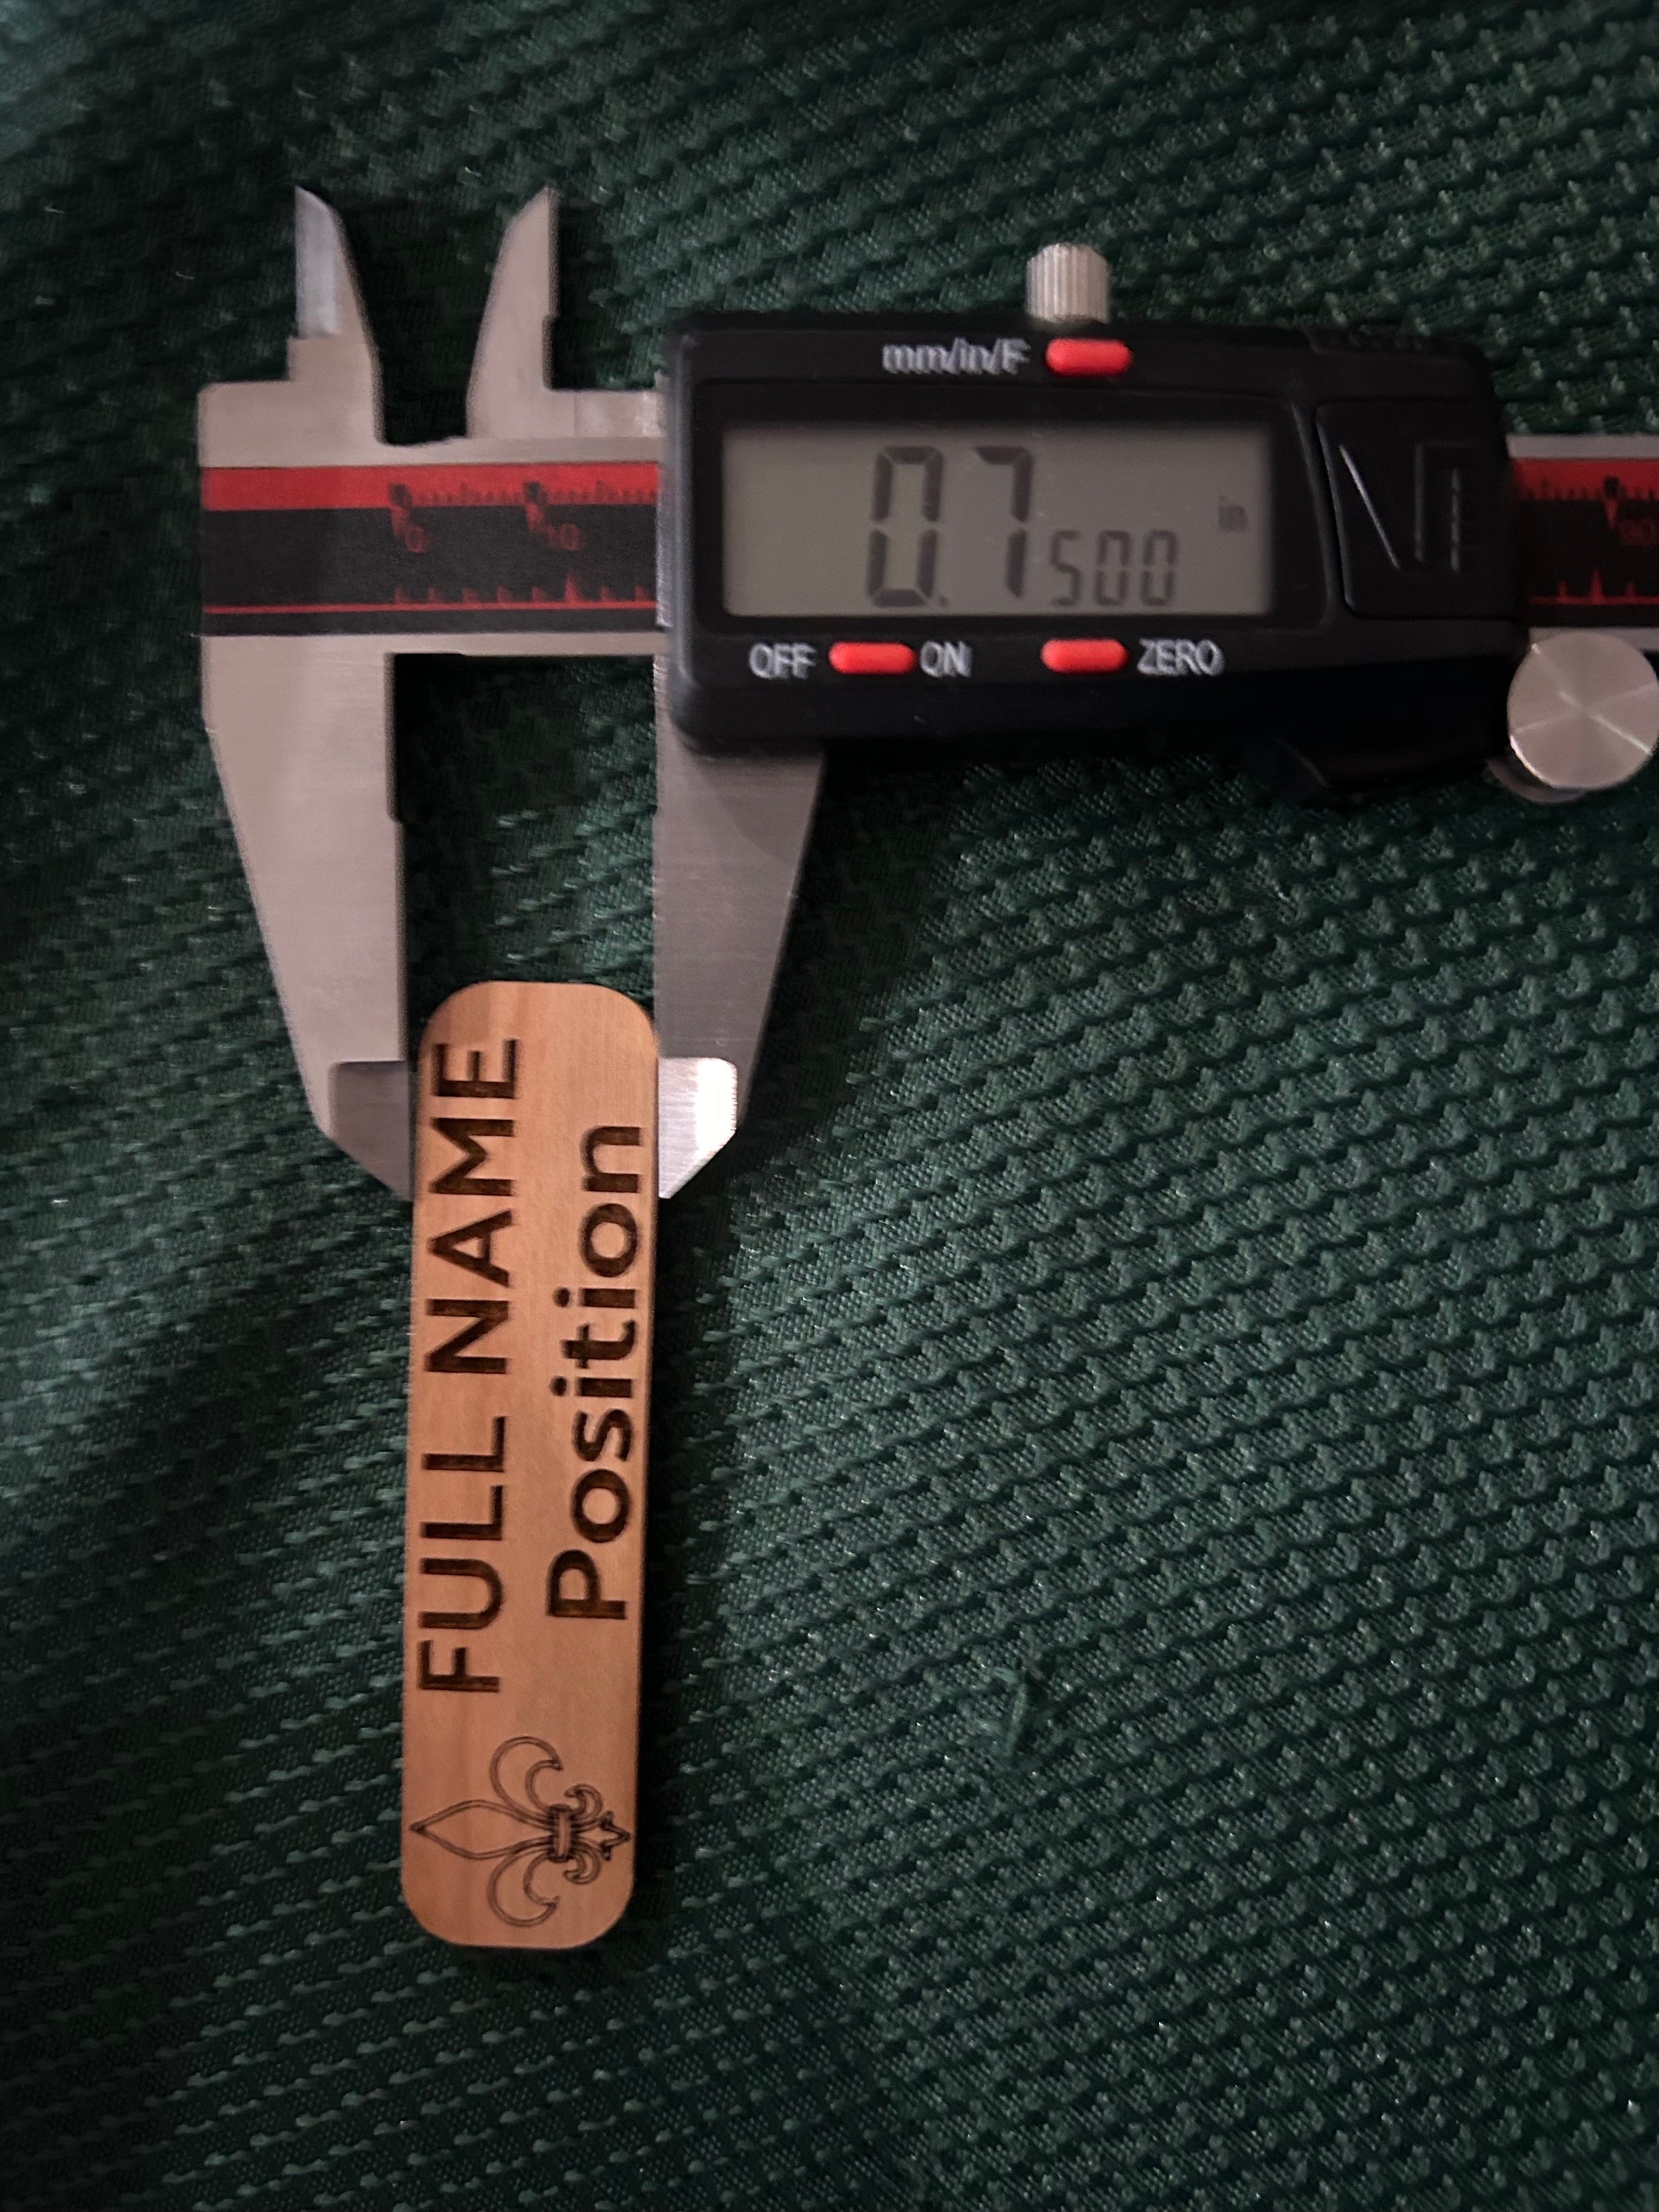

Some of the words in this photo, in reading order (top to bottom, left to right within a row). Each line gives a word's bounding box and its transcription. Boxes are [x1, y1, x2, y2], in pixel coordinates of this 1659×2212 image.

[883, 336, 1031, 375] mm/in/F
[866, 445, 1178, 608] 0.7500
[1218, 495, 1250, 533] in
[748, 641, 817, 680] OFF
[919, 639, 973, 678] ON
[1136, 639, 1225, 677] ZERO
[423, 1039, 521, 1374] NAME
[546, 1126, 644, 1620] Position
[416, 1416, 509, 1693] FULL
